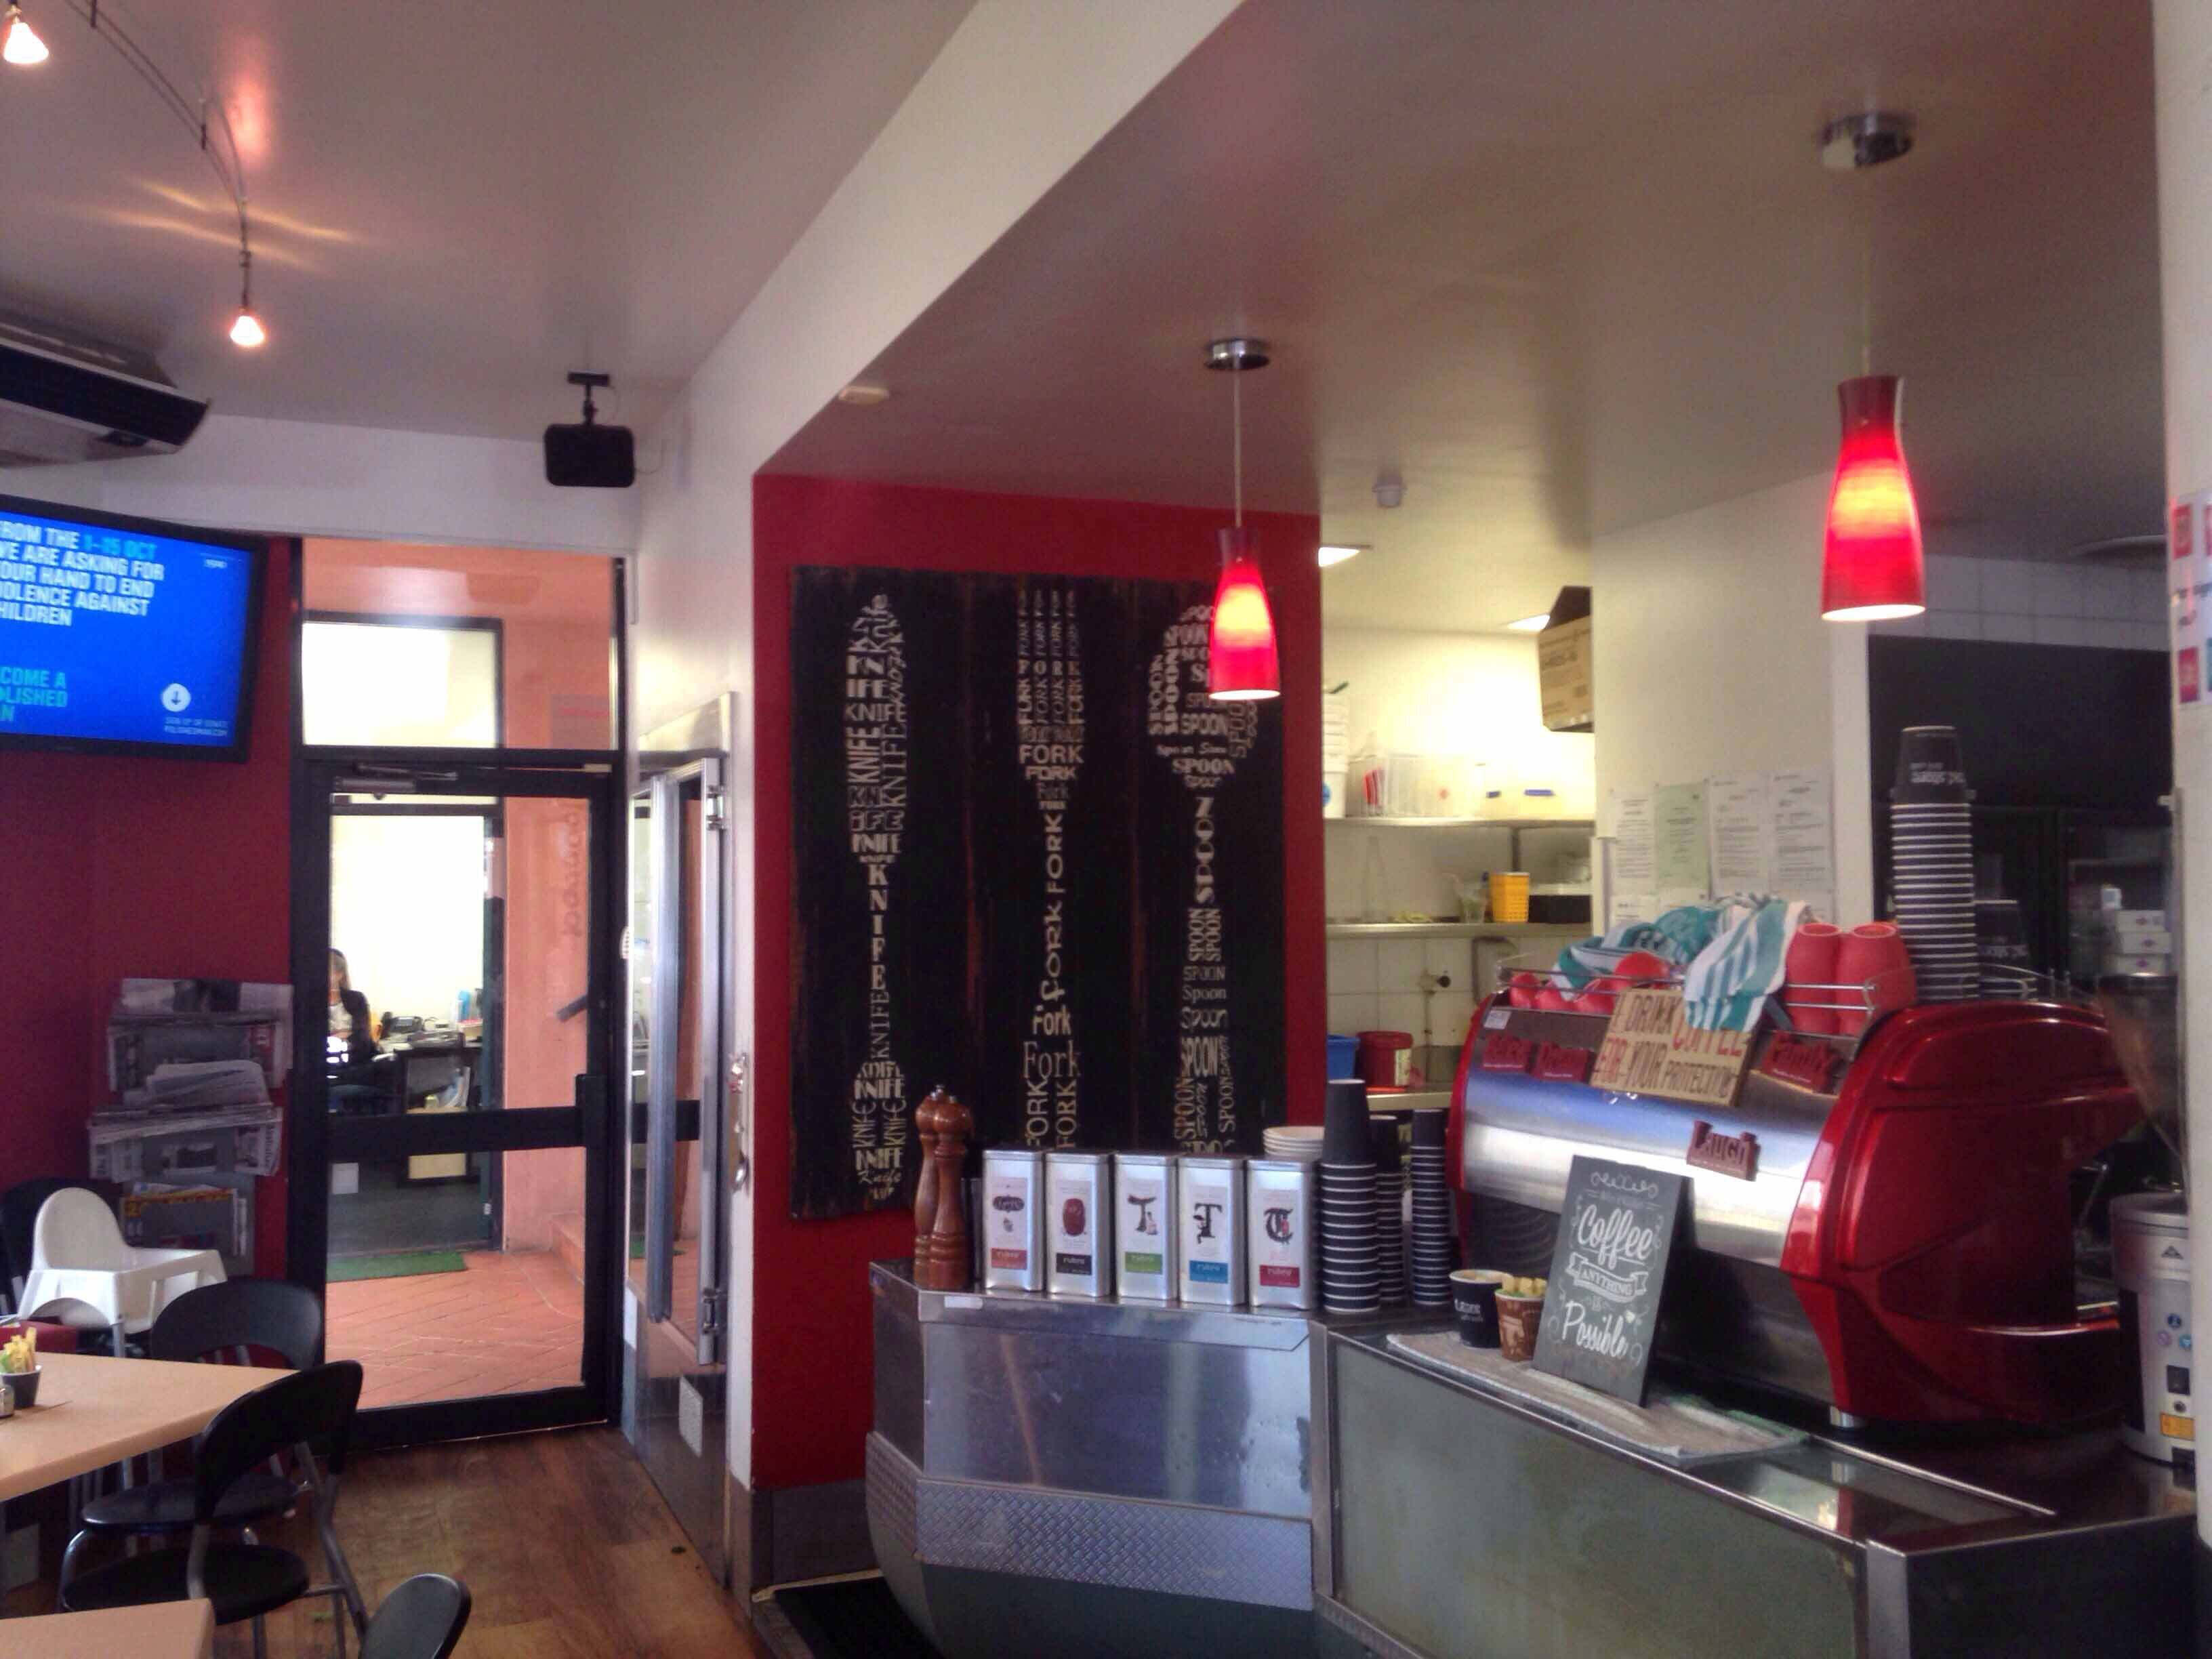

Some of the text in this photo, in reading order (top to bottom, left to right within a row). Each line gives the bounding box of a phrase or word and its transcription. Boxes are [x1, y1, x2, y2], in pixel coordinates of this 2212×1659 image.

[45, 527, 80, 550] THE
[22, 544, 60, 566] ARE
[62, 550, 129, 576] ASKING
[130, 560, 165, 581] FOR
[39, 567, 91, 590] HAND
[94, 574, 117, 593] TO
[119, 577, 155, 598] END
[74, 590, 150, 616] AGAINST
[0, 667, 66, 689] COME A
[845, 701, 907, 723] KNIFE
[846, 725, 881, 783] KNIFE
[881, 722, 907, 808] KNIFE
[1019, 744, 1085, 764] FORK
[1025, 765, 1078, 781] FORK
[1044, 813, 1065, 893] FORK
[867, 863, 890, 990] KNIFE
[1187, 908, 1204, 962] SPOON
[1205, 908, 1221, 962] SPOON
[1183, 964, 1226, 982] SPOON
[1182, 985, 1227, 1004] Spoon
[869, 991, 890, 1059] KNIFE
[1031, 1004, 1072, 1036] Fork
[1023, 1039, 1082, 1079] Fork
[853, 1079, 906, 1100] KNIFE
[1055, 1078, 1078, 1149] FORK
[1577, 1204, 1653, 1269] Coffee
